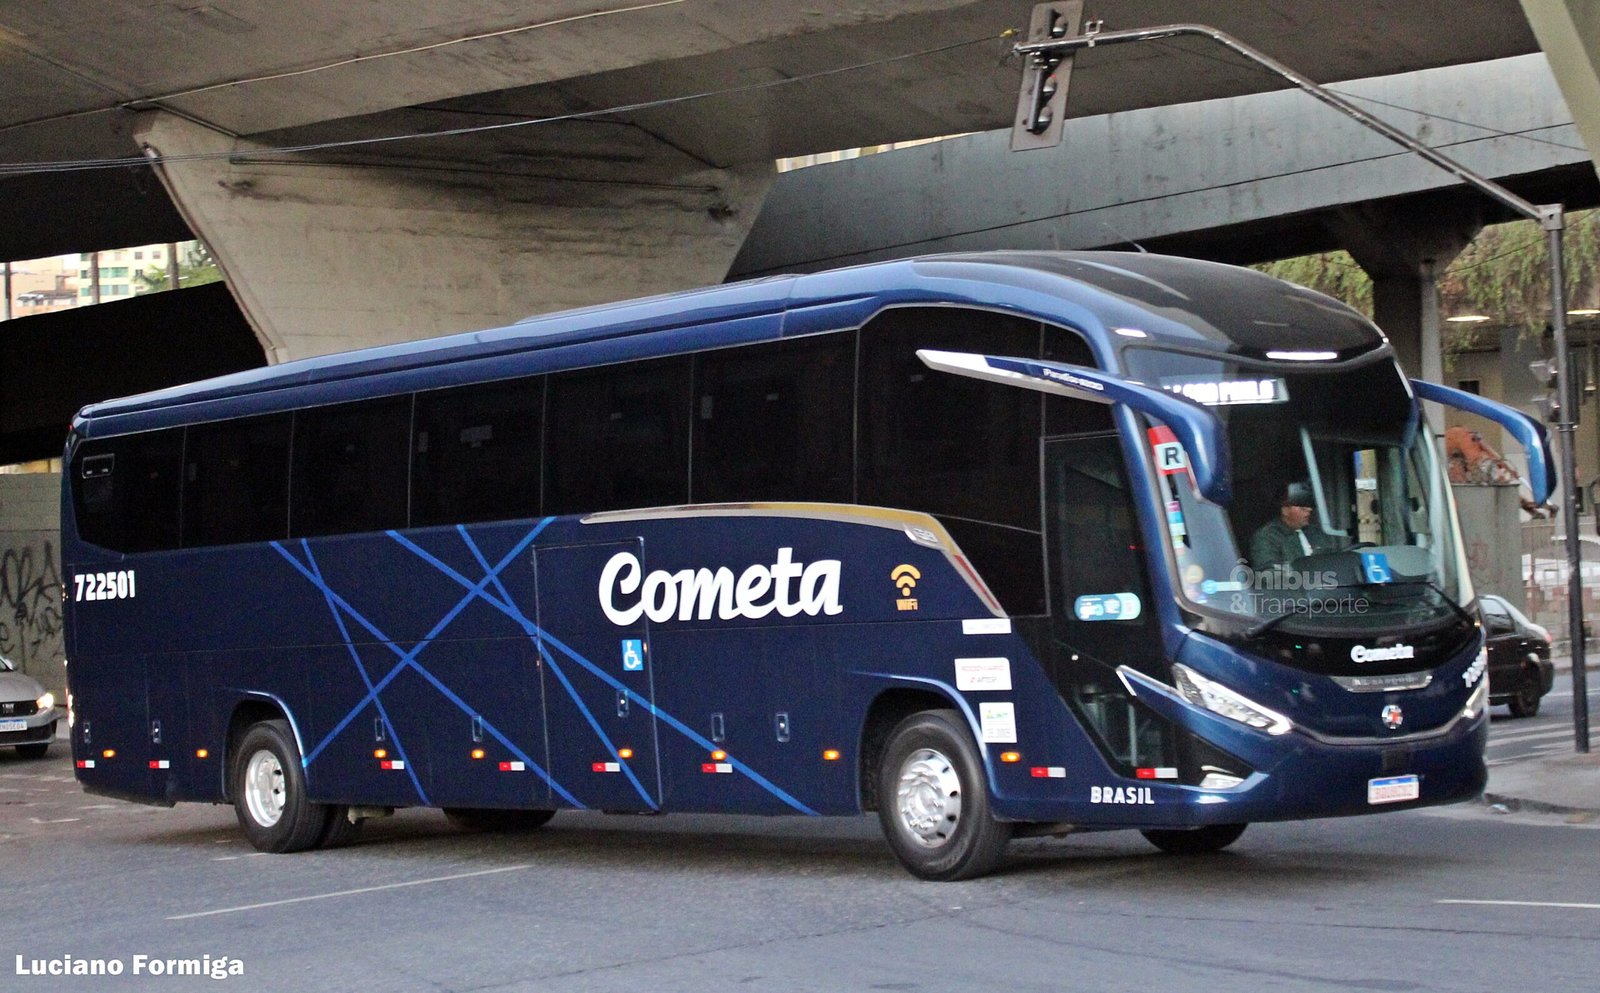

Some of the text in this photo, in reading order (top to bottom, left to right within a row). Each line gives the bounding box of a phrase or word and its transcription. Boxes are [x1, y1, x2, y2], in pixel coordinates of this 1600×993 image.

[1165, 447, 1181, 465] R
[75, 570, 135, 601] 722501
[599, 547, 843, 626] Cometa
[1090, 786, 1155, 804] BRASIL
